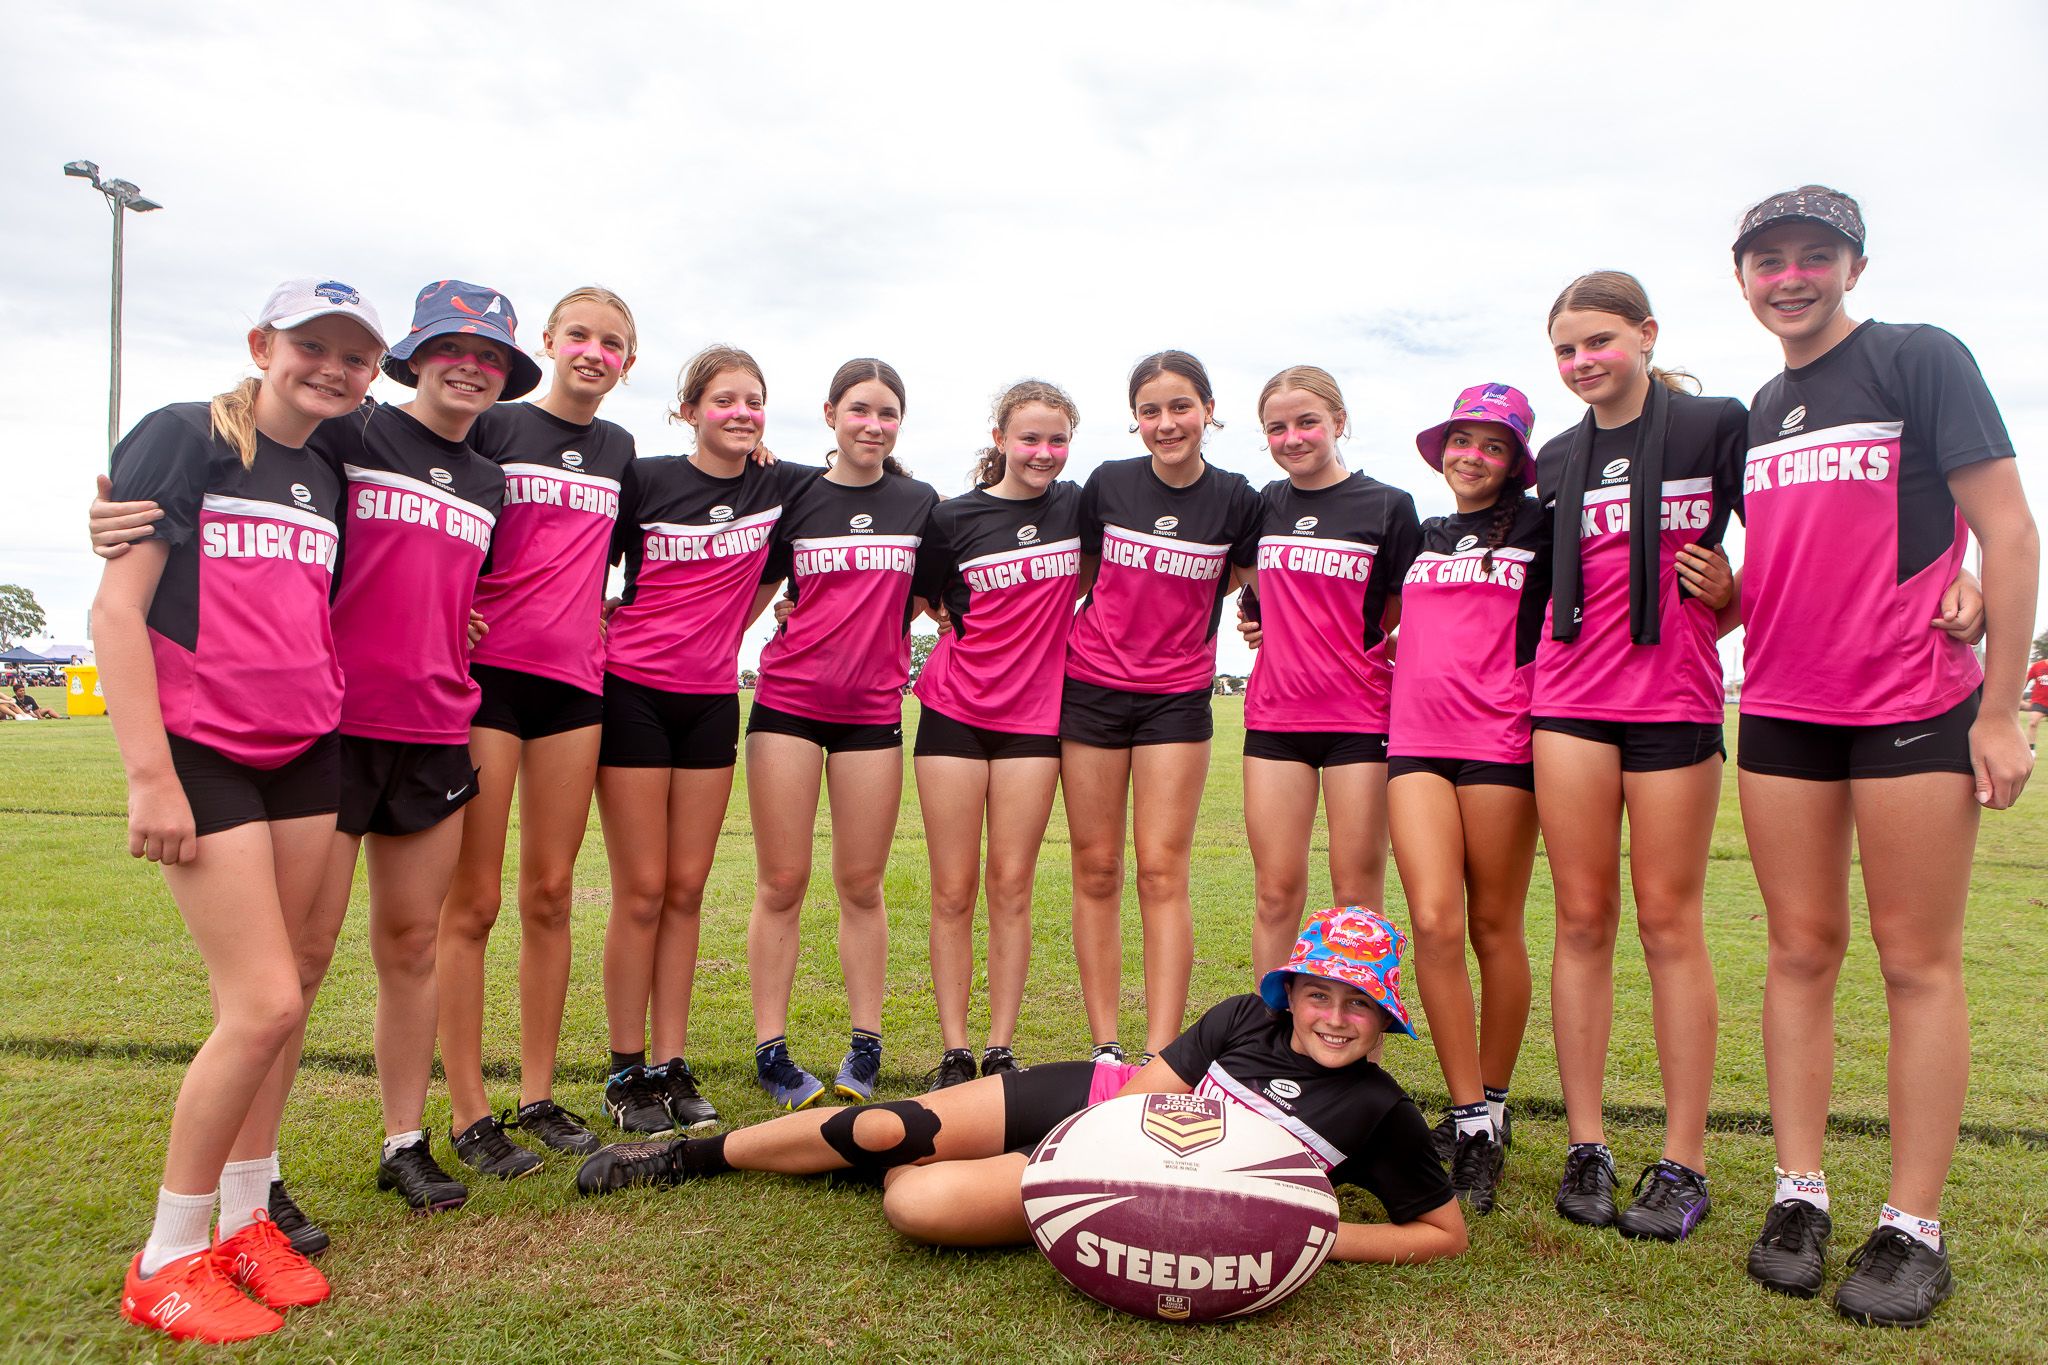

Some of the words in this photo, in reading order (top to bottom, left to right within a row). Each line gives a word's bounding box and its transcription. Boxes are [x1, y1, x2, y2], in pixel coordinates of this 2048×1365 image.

[1778, 424, 1805, 437] STRUDDYS
[562, 462, 586, 473] STRUDDYS
[1777, 445, 1890, 487] CHICKS
[431, 478, 456, 494] STRUDDYS
[1601, 475, 1629, 485] STRUDDYS
[568, 483, 619, 521] CHIC
[355, 489, 441, 530] SLICK
[445, 507, 492, 554] CHIC
[202, 522, 295, 560] SLICK
[646, 535, 710, 561] SLICK
[1018, 538, 1041, 546] STRUDDYS
[795, 548, 850, 577] SLICK
[1103, 536, 1151, 570] SLICK
[1153, 549, 1224, 580] CHICKS
[1287, 547, 1370, 582] CHICKS
[967, 560, 1027, 593] SLICK
[1436, 558, 1525, 590] CHICKS
[1329, 936, 1360, 948] smuggler
[1155, 1104, 1216, 1116] FOOTBALL
[1166, 1100, 1205, 1108] TOUCH
[1262, 1087, 1293, 1111] STRUDDYS
[1076, 1230, 1273, 1291] STEEDEN
